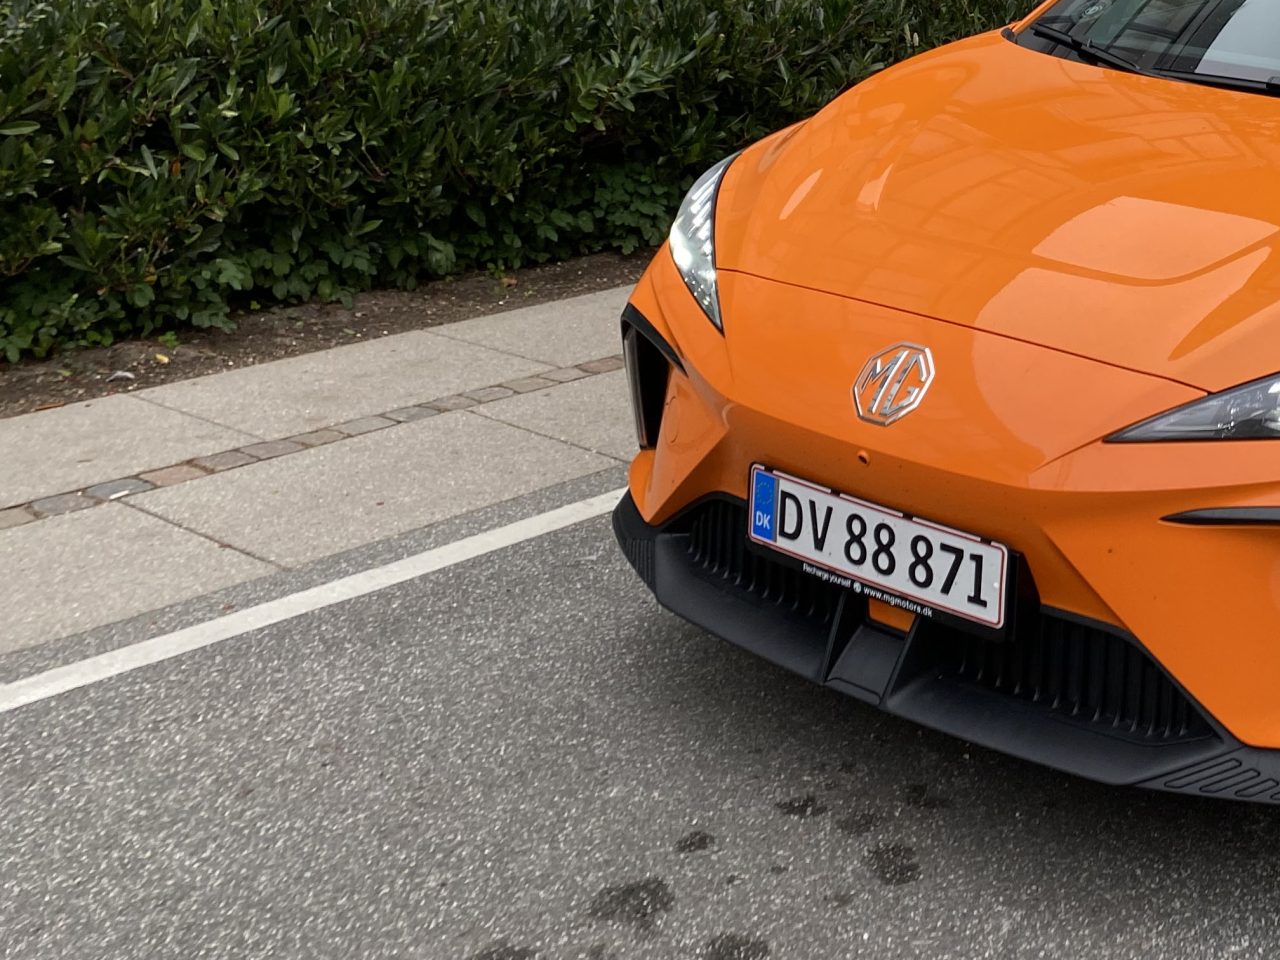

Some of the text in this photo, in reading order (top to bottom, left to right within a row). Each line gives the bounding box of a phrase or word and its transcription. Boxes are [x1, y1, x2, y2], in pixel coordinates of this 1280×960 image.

[860, 349, 928, 416] MG
[755, 510, 771, 530] DK
[778, 489, 988, 608] DV 88 871
[863, 586, 933, 618] www.mgmotors.dk
